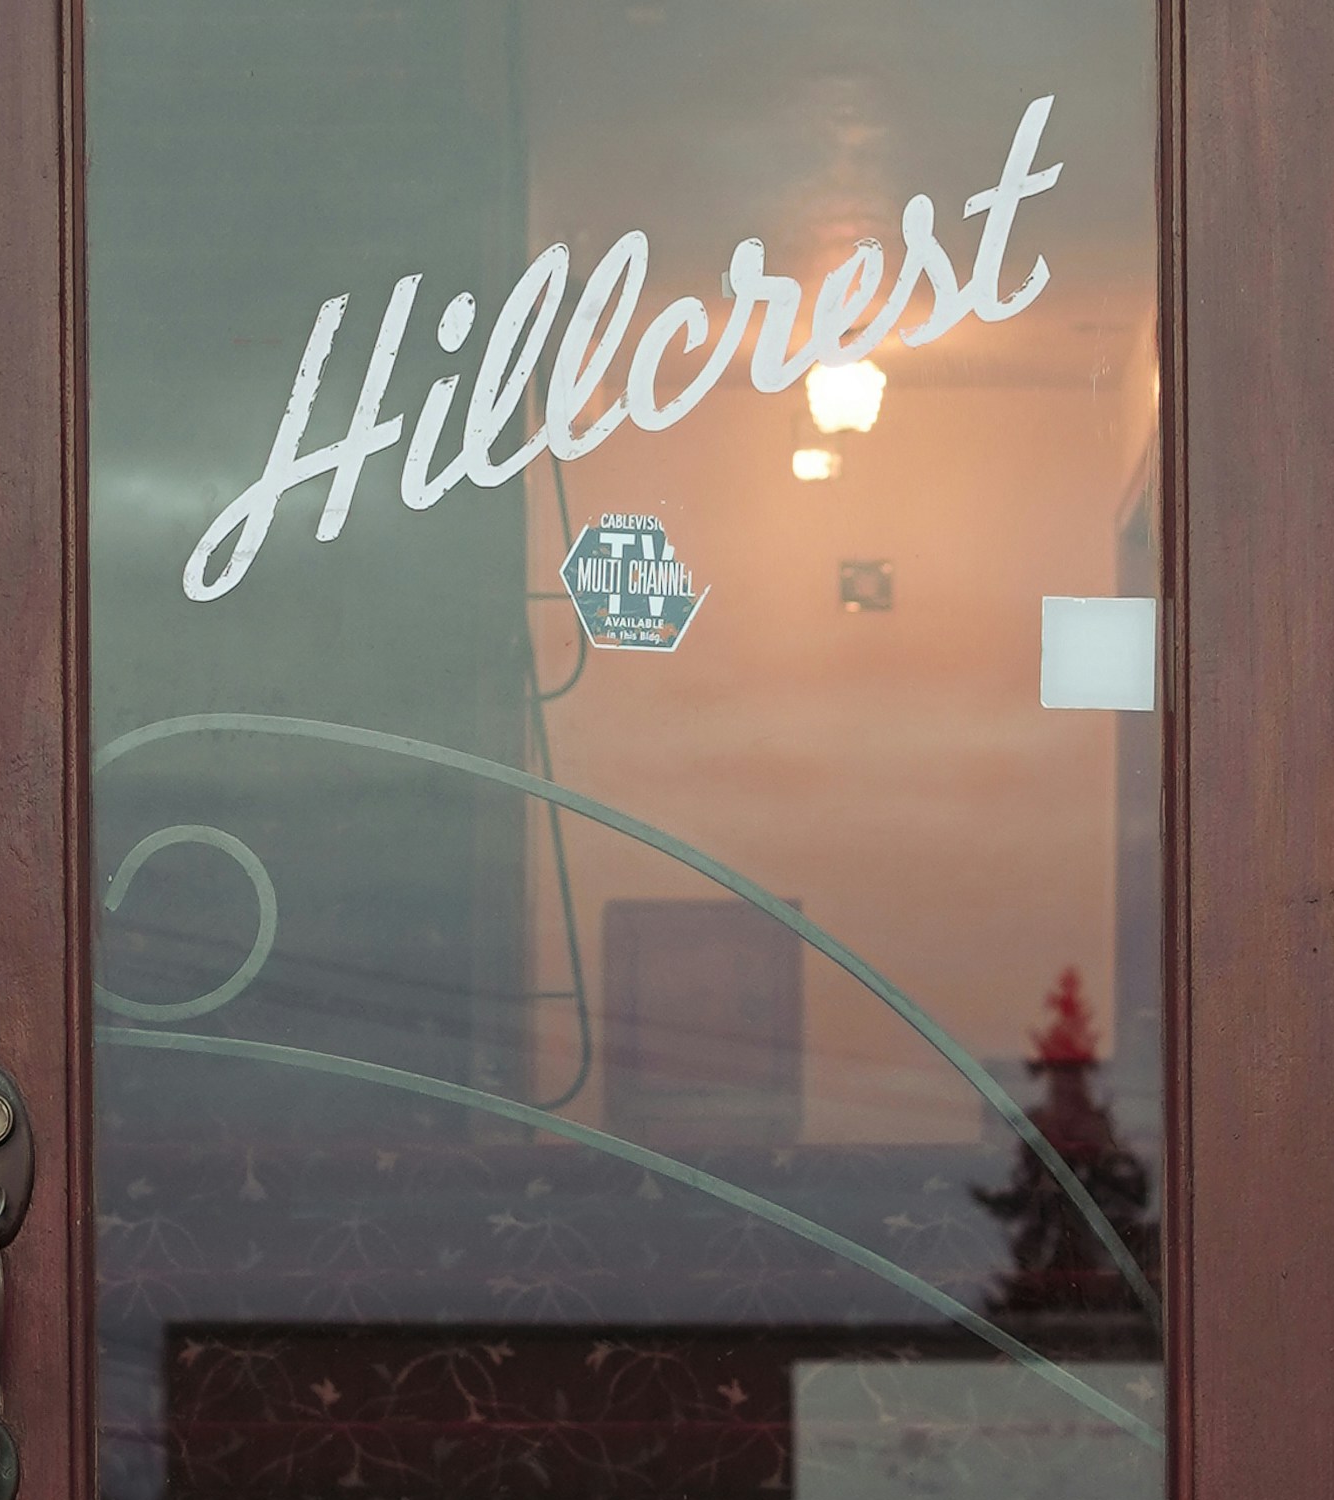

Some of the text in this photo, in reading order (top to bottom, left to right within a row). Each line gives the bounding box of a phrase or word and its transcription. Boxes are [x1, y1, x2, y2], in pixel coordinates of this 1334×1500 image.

[182, 94, 1064, 603] Hillcrest
[577, 557, 696, 597] MULTI CHANNEL
[599, 532, 676, 617] TV
[604, 616, 665, 629] AVAILABLE
[606, 629, 616, 639] in
[619, 630, 638, 641] this
